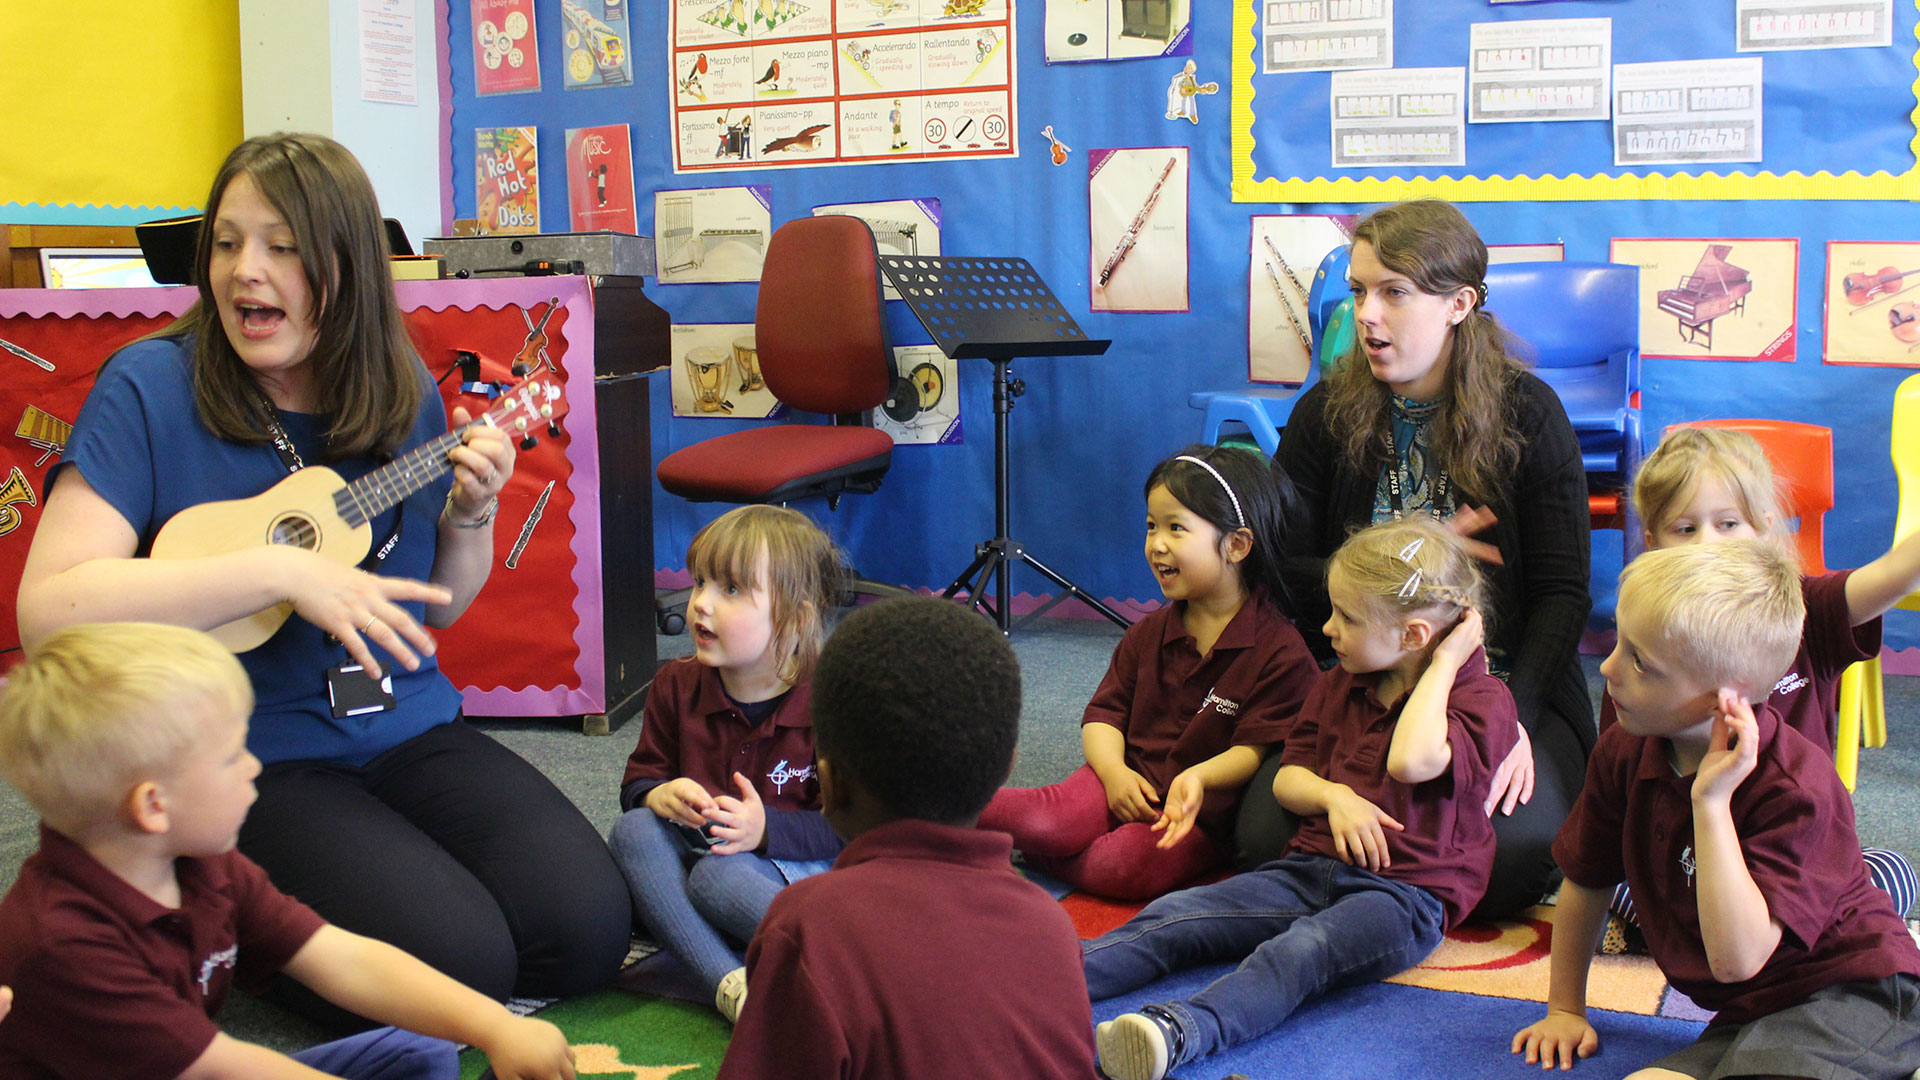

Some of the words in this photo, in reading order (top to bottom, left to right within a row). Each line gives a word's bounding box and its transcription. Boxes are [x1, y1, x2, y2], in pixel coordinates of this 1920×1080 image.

[873, 41, 916, 52] Accelerando
[924, 38, 970, 49] Rallentando
[1165, 27, 1190, 55] PERCUSSION
[710, 57, 731, 66] Mezzo
[732, 55, 750, 67] forte
[782, 51, 805, 59] Mezzo
[807, 49, 828, 59] piano
[844, 111, 878, 121] Andante
[925, 101, 932, 109] A
[934, 100, 959, 110] tempo
[682, 122, 715, 132] Fortissimo
[928, 125, 942, 137] 30
[987, 121, 1002, 134] 30
[487, 150, 516, 179] Red
[1090, 149, 1115, 177] WOODWIND
[498, 170, 528, 197] Hot
[750, 187, 771, 210] PERCUSSION
[499, 205, 536, 227] Dots
[917, 199, 939, 224] PERCUSSION
[1764, 331, 1792, 357] STRINGS
[941, 418, 960, 443] PERCUSSION
[1389, 470, 1400, 495] STAFF
[1437, 470, 1448, 496] STAFF
[377, 533, 400, 560] STAFF
[1210, 693, 1239, 709] Hamilton
